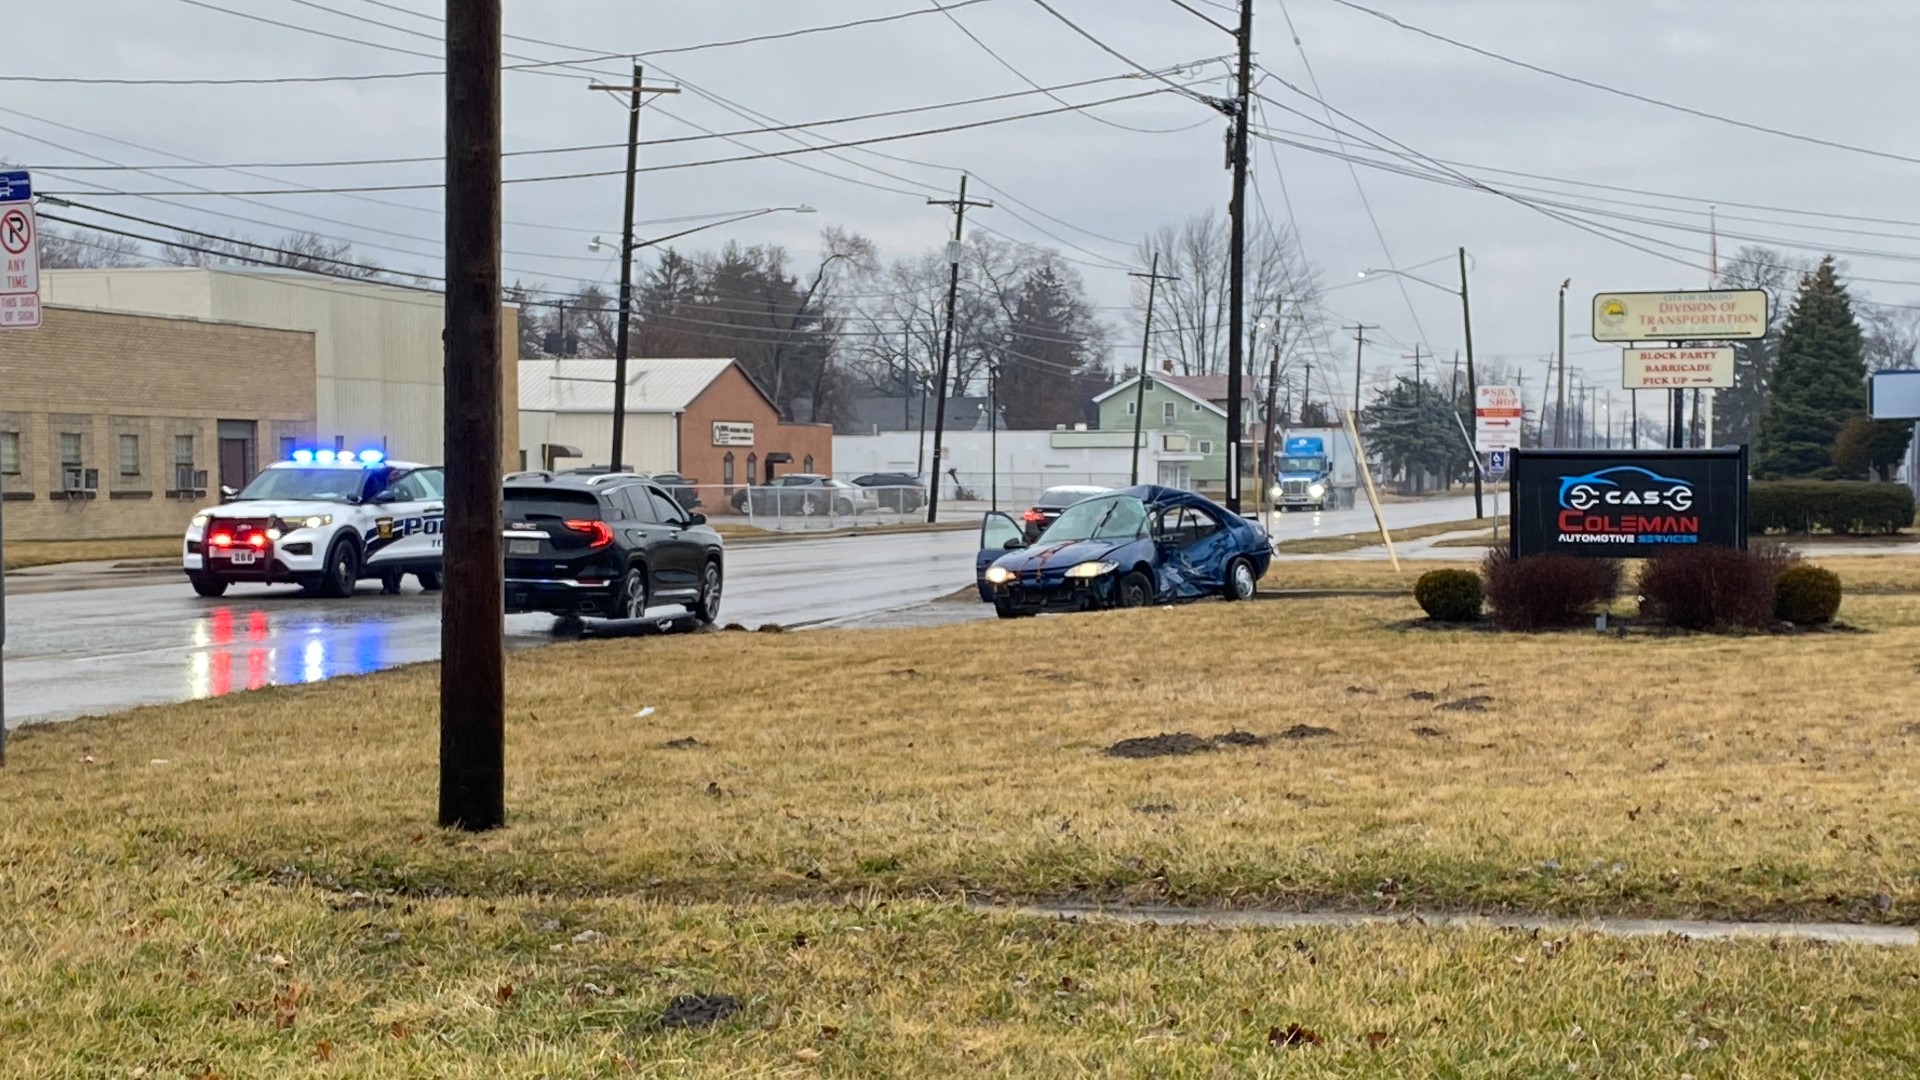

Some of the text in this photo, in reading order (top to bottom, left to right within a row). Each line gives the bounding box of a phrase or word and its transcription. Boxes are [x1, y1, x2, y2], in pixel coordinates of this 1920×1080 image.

[7, 259, 26, 271] ANY
[6, 275, 28, 289] TIME
[1, 296, 37, 308] THIS SIDE
[1659, 302, 1737, 313] DIVISION OF
[4, 310, 35, 321] OF SIGN
[1640, 314, 1759, 326] TRANSPORTATION
[1640, 351, 1718, 360] BLOCK PARTY
[1645, 364, 1712, 372] BARRICADE
[1643, 377, 1670, 385] PICK
[1490, 388, 1516, 396] SIGN
[1488, 398, 1518, 406] SHOP
[1605, 491, 1661, 505] CAS
[1558, 510, 1698, 532] COLEMAN
[1558, 534, 1698, 543] AUTOMOTIVE SERVICES
